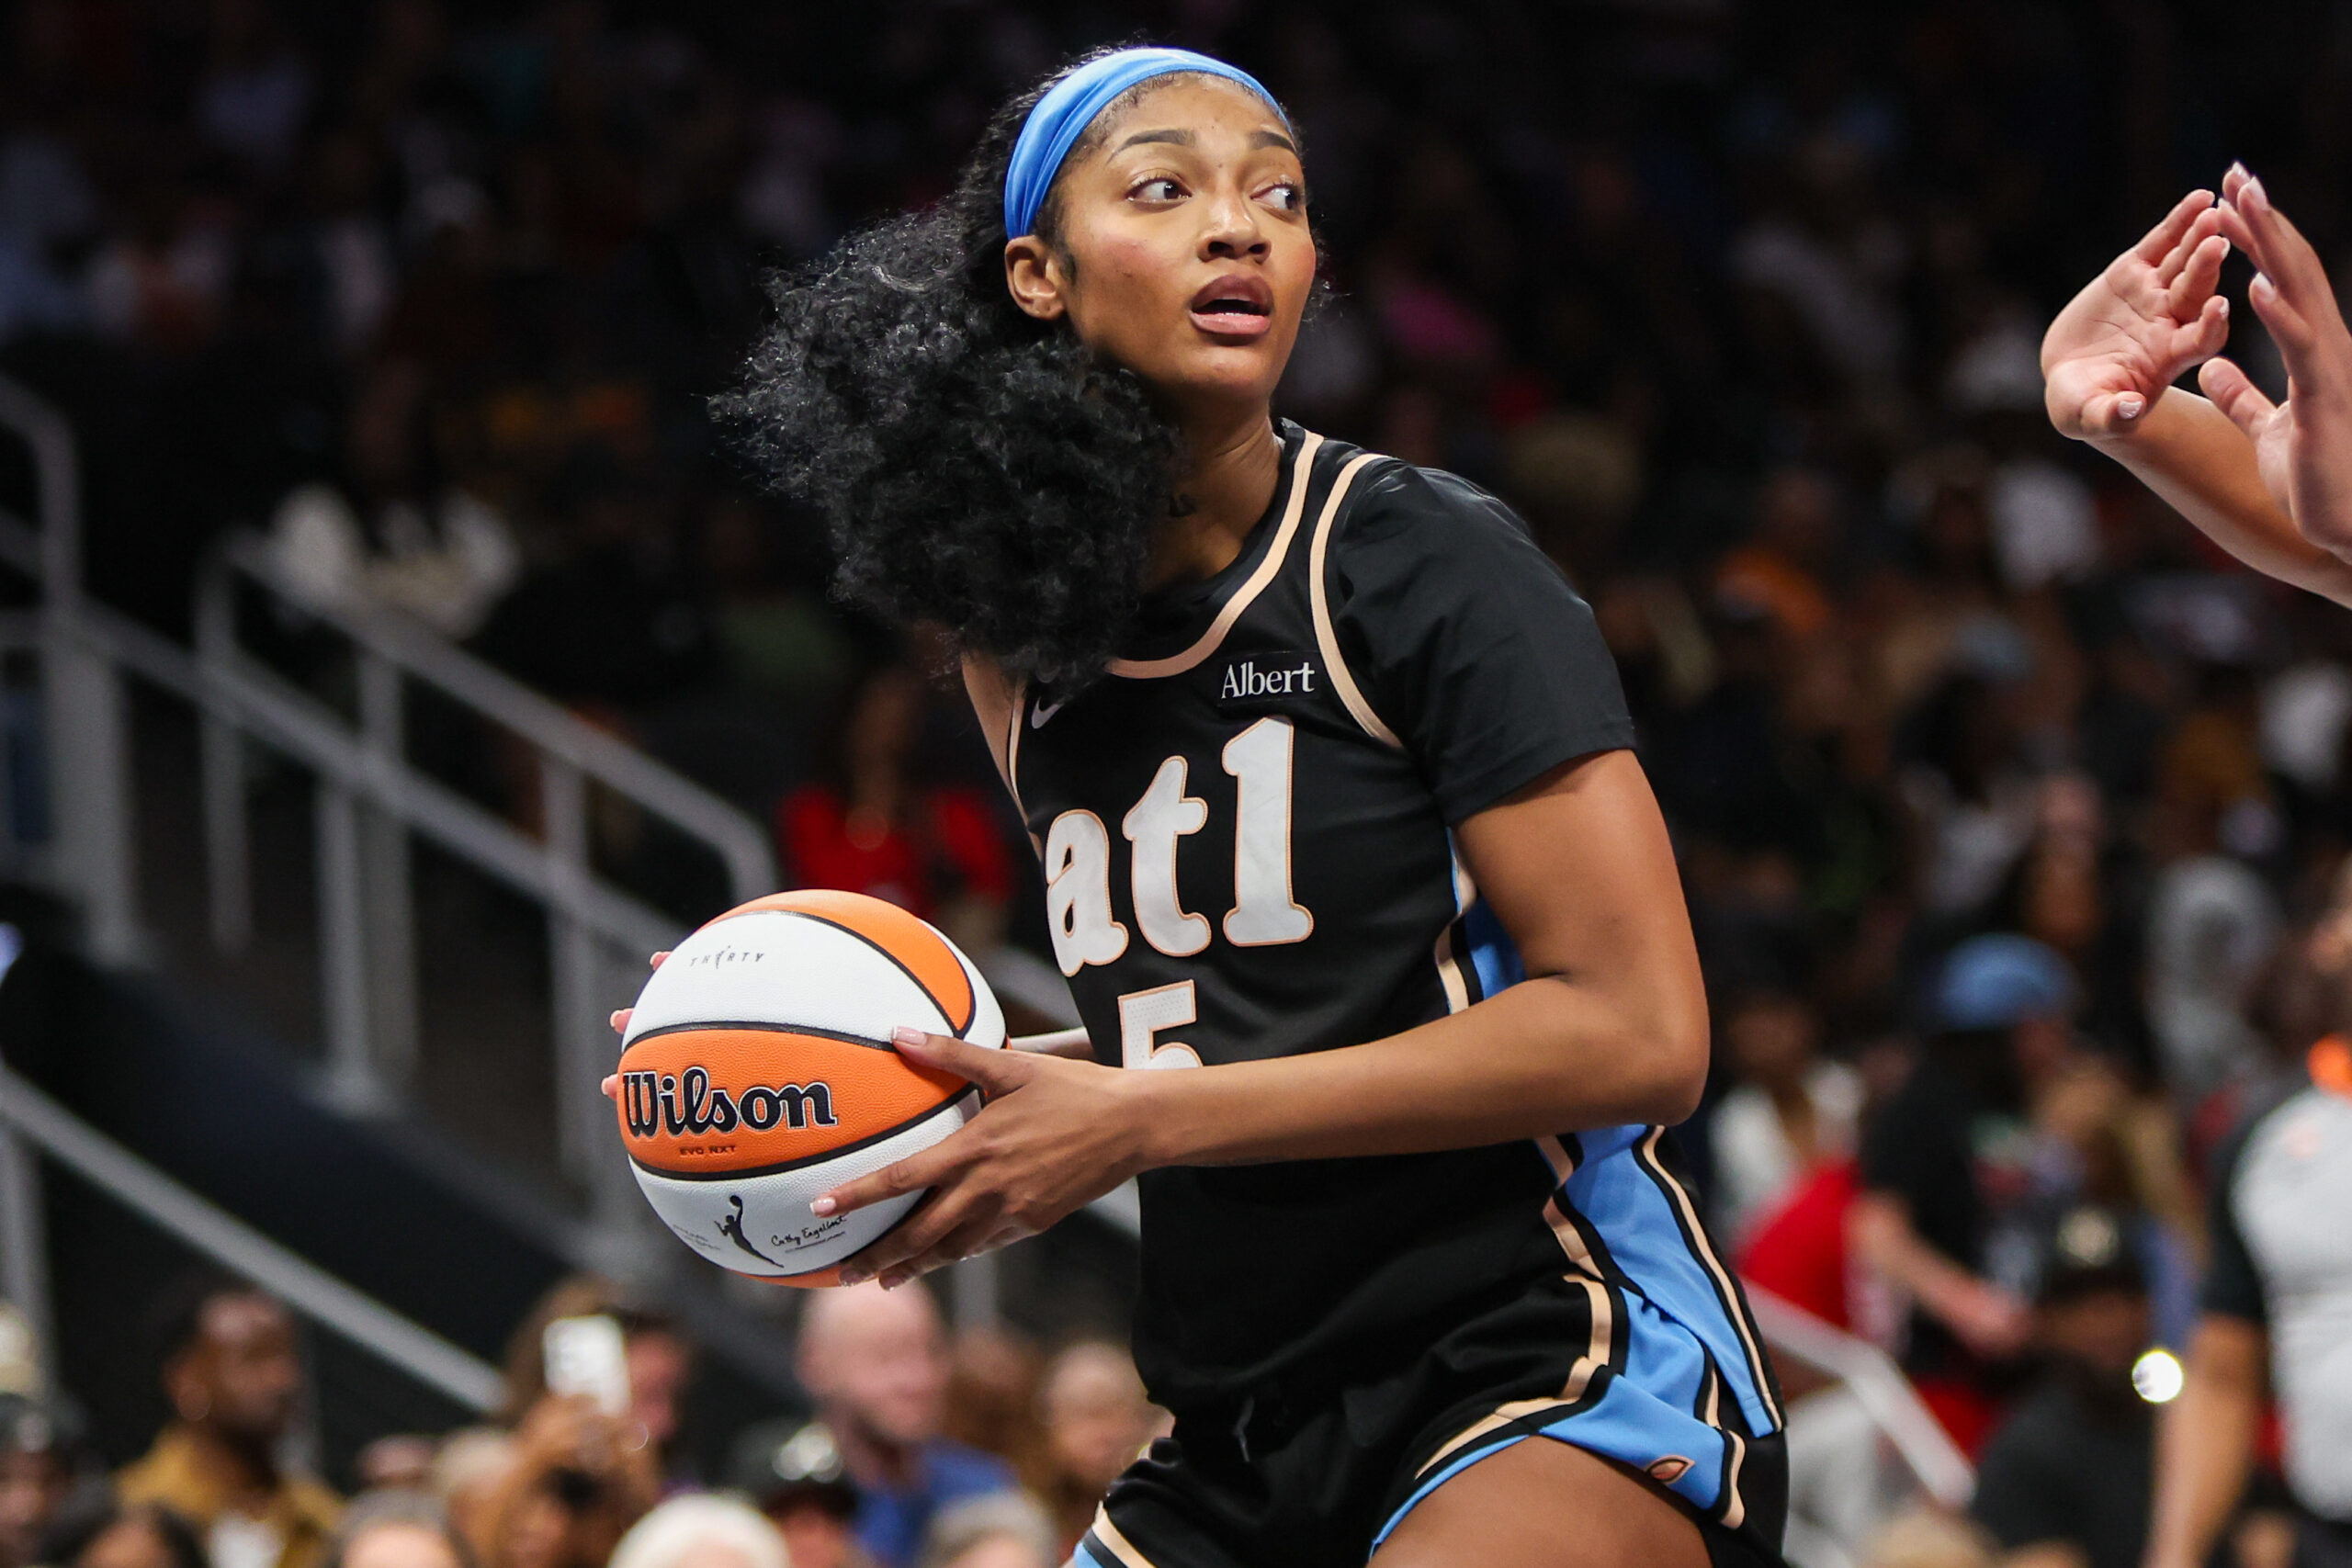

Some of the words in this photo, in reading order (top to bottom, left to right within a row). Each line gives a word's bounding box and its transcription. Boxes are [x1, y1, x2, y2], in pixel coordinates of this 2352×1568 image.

[1221, 660, 1315, 699] Albert
[1045, 715, 1314, 977] atl
[623, 1065, 839, 1139] Wilson
[680, 1146, 704, 1156] EVO
[708, 1145, 736, 1154] NXT
